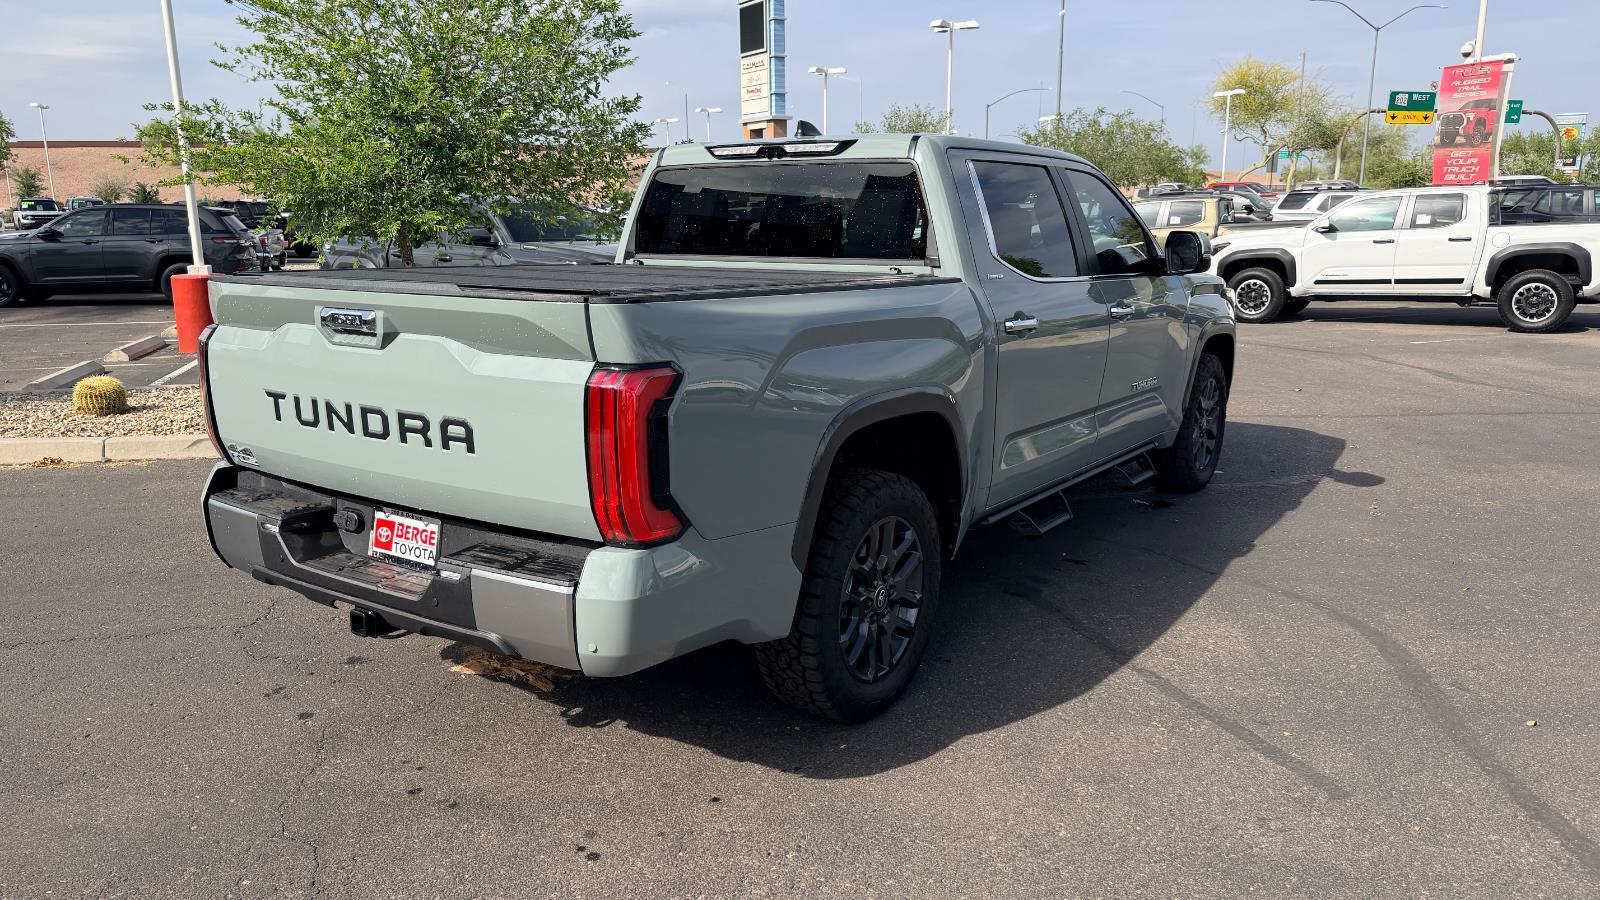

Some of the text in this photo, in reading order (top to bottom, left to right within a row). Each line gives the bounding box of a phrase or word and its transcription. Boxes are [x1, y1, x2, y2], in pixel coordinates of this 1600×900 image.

[1451, 77, 1491, 87] RUGGED
[1450, 150, 1475, 158] GET
[1442, 165, 1481, 173] TRUCK
[263, 388, 476, 455] TUNDRA
[396, 522, 436, 546] BERGE
[394, 541, 436, 561] TOYOTA
